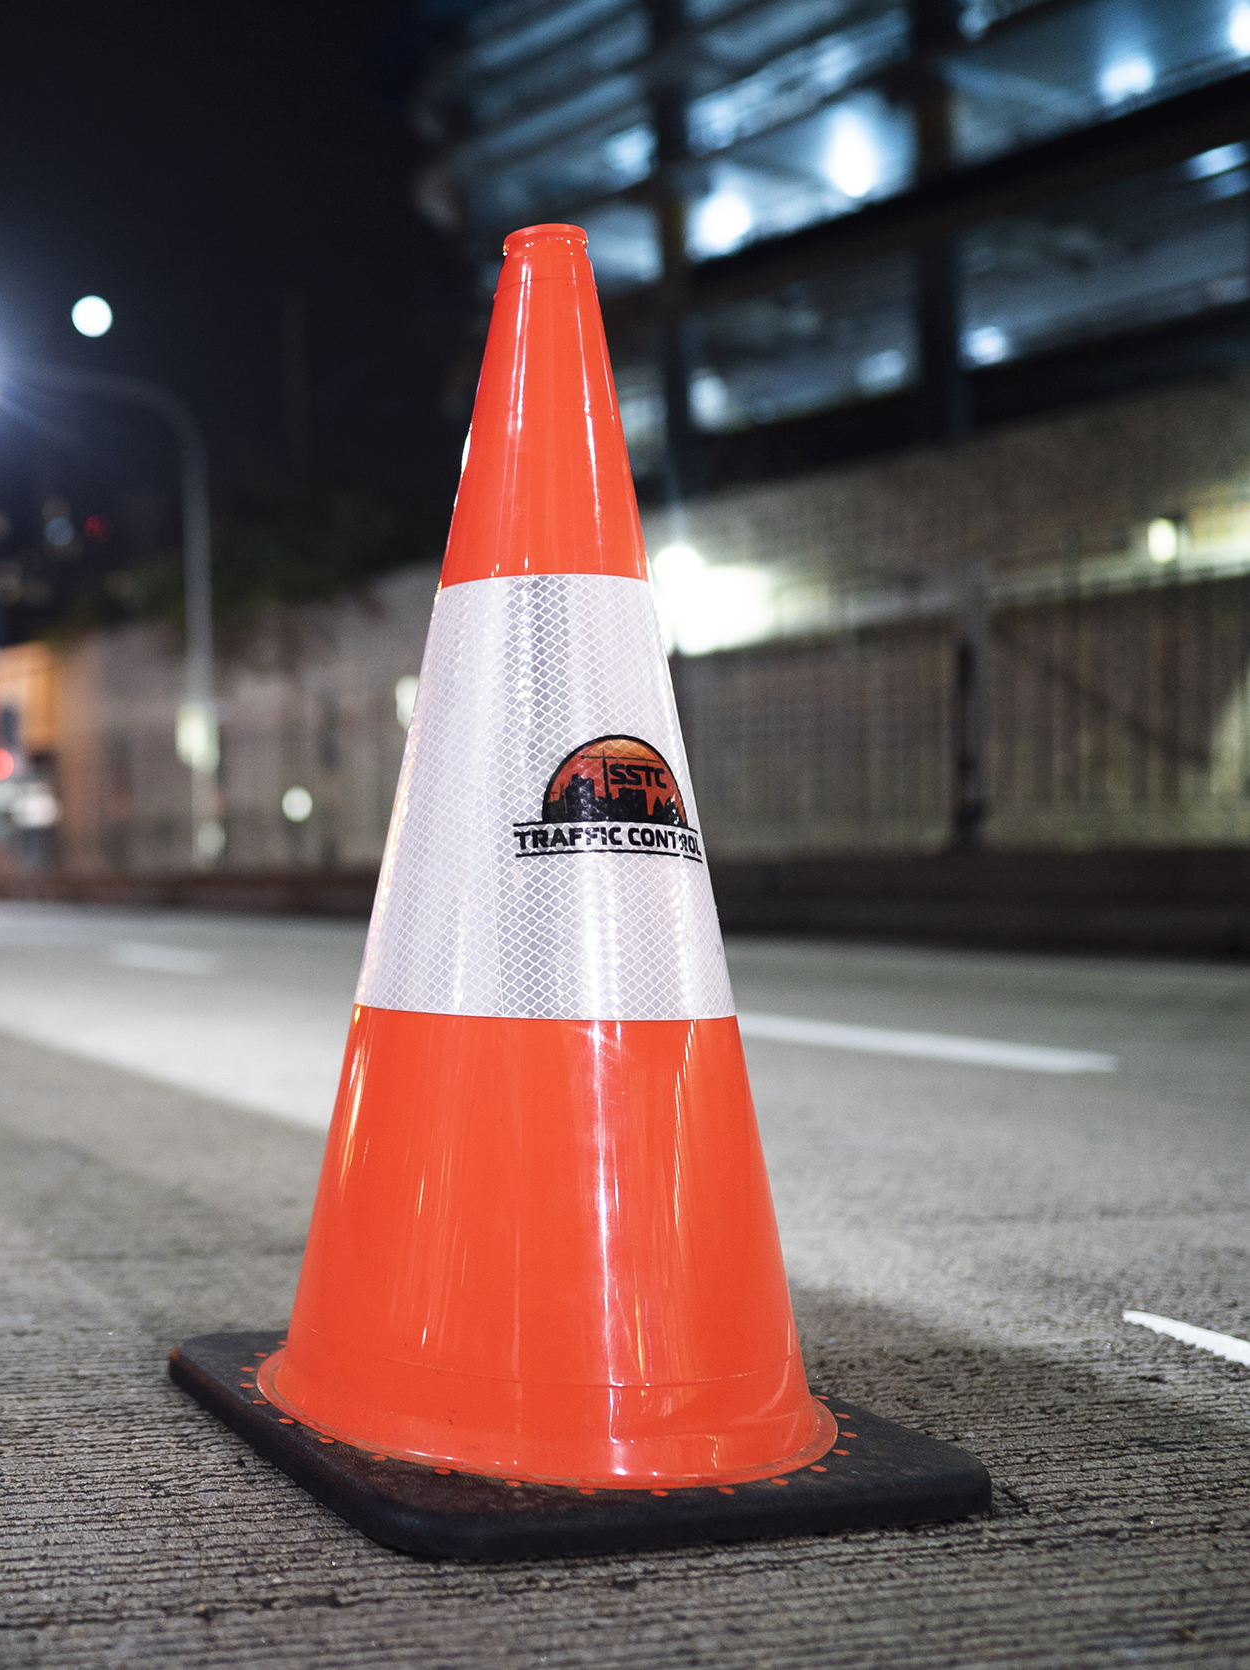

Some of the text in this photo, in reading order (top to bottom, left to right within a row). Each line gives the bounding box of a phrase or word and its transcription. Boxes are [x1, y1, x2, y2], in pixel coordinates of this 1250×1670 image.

[609, 763, 667, 789] SSTC
[513, 827, 702, 857] TRAFFIC CONTROL
